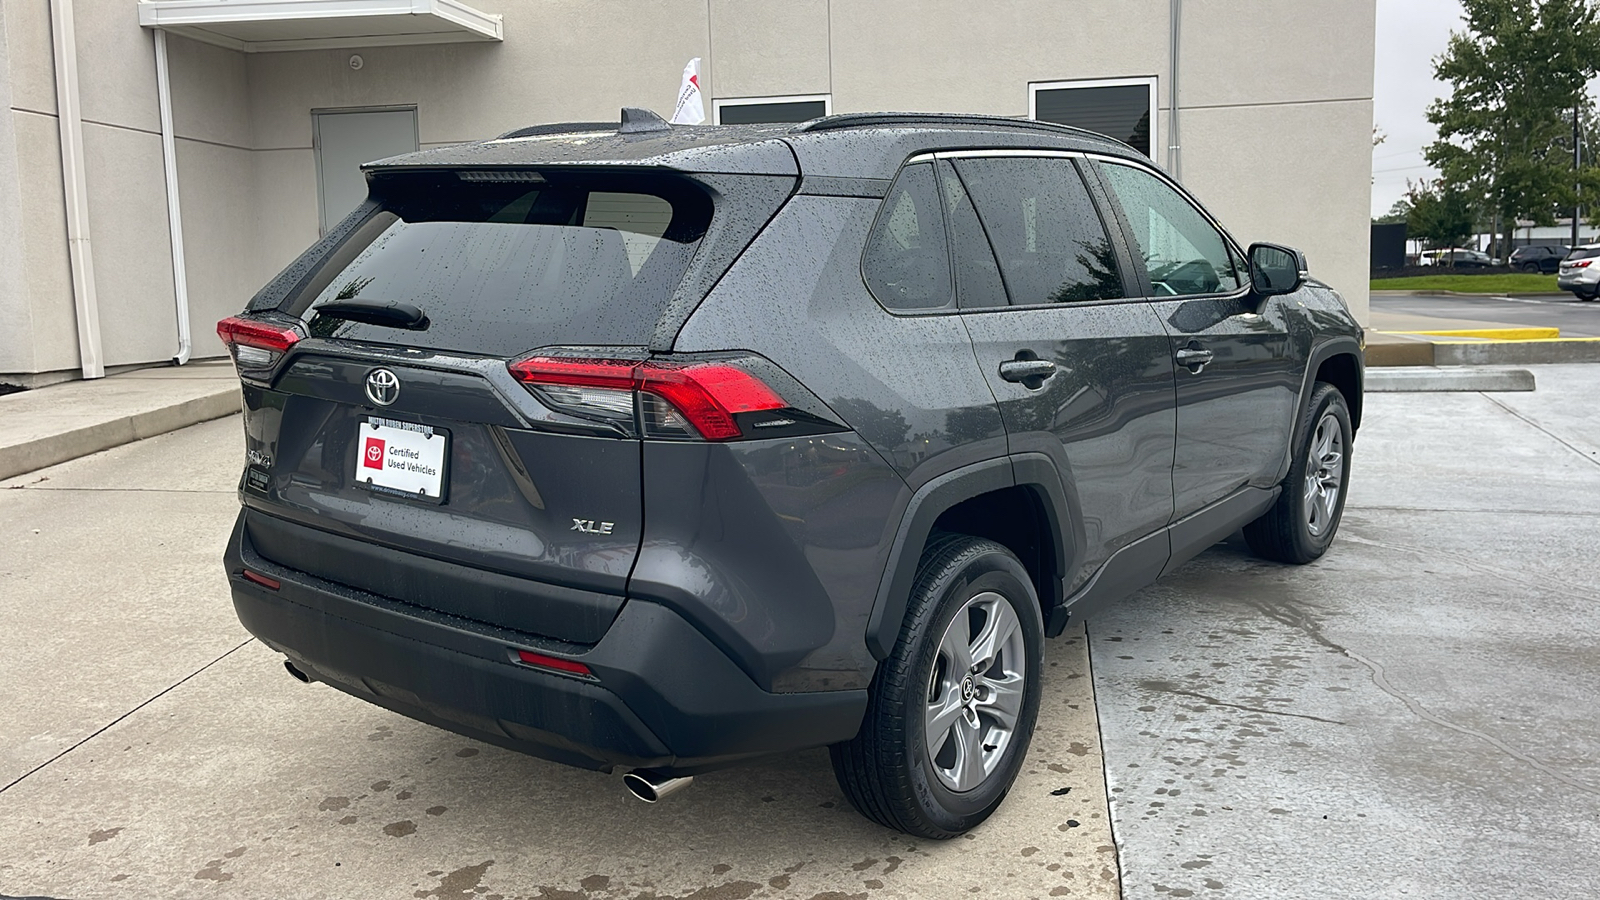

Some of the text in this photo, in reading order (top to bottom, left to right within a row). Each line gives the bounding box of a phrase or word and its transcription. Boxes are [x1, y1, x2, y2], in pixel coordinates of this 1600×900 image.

[402, 421, 434, 435] SUPERSTORE
[388, 446, 420, 460] Certified
[387, 458, 437, 476] Used Vehicles
[570, 518, 615, 535] XLE
